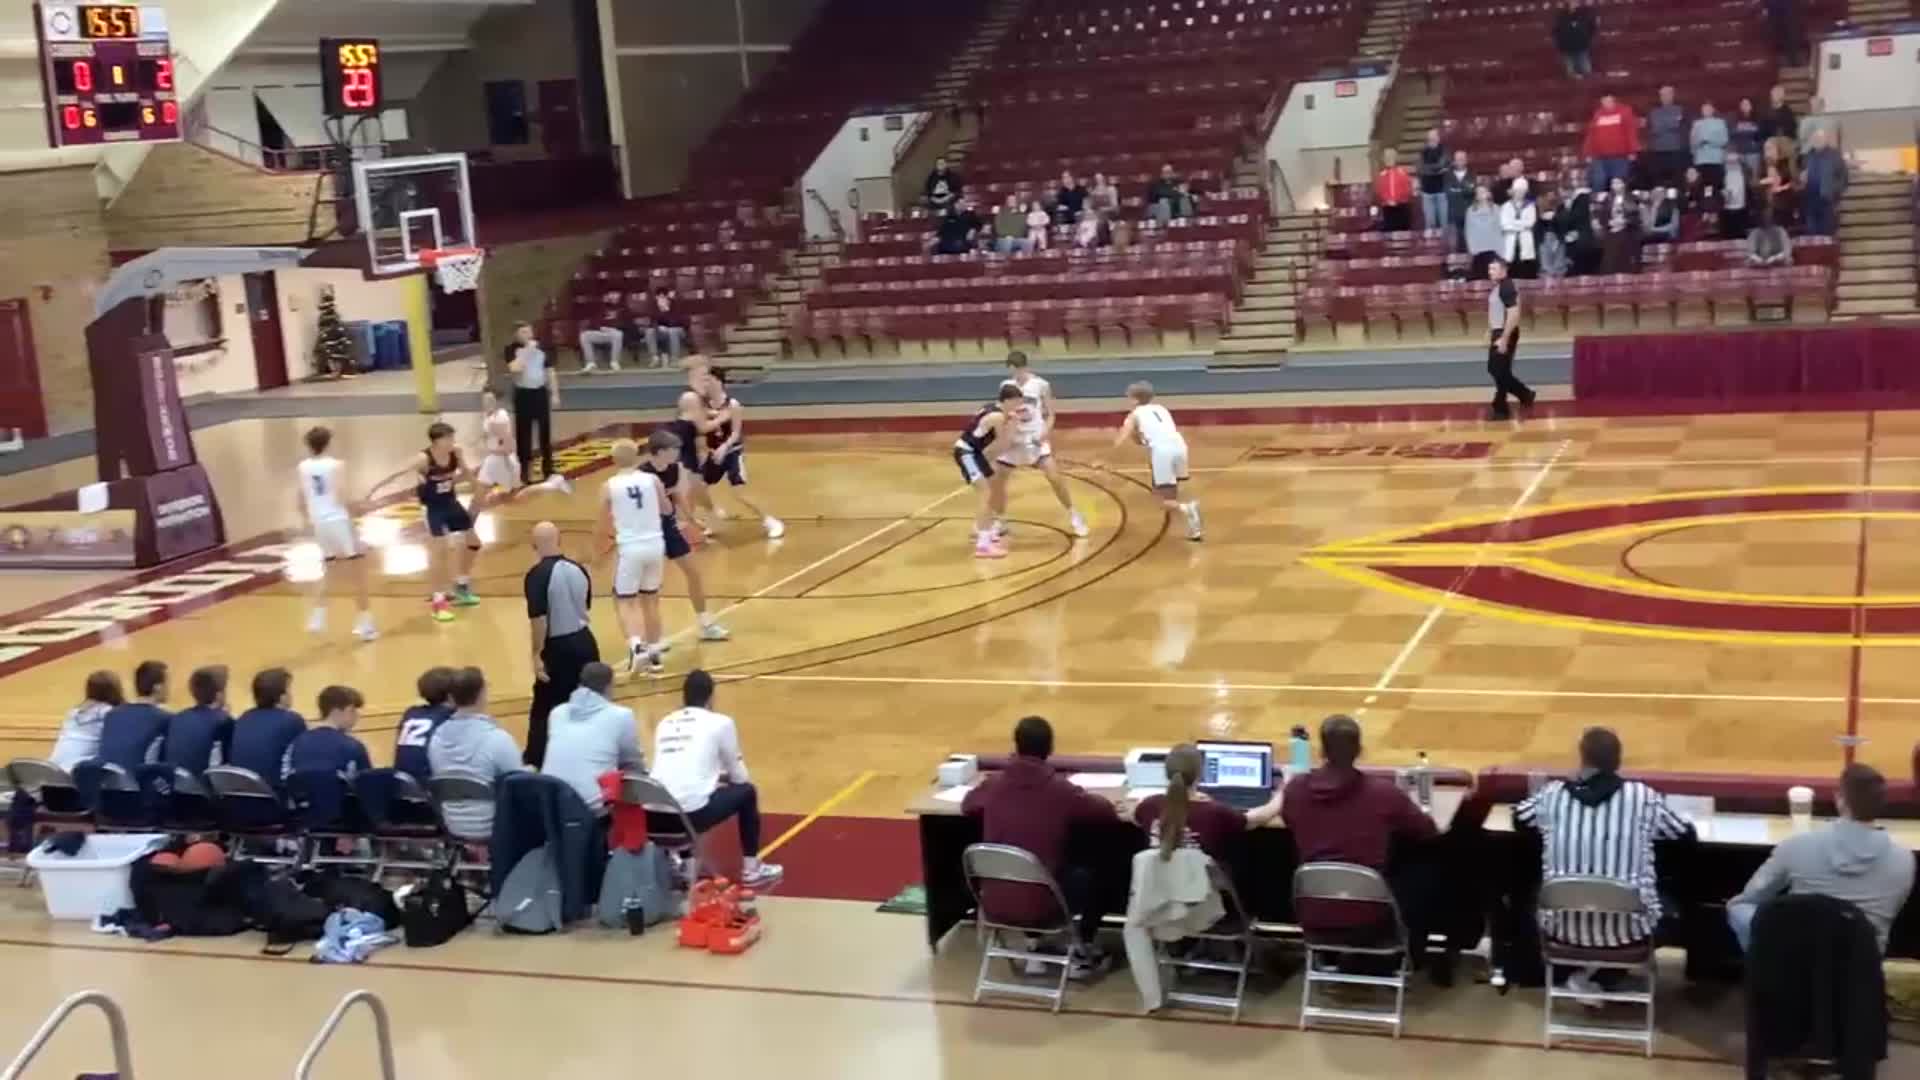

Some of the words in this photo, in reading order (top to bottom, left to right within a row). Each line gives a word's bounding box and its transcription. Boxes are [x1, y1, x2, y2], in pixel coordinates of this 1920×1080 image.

[73, 61, 92, 91] 0
[111, 65, 124, 84] 1
[155, 60, 172, 88] 2
[342, 69, 375, 107] 23
[63, 105, 80, 129] 0
[83, 109, 97, 127] 6
[142, 107, 156, 124] 6
[1151, 410, 1163, 423] 1
[626, 485, 643, 509] 4
[398, 718, 433, 746] 12
